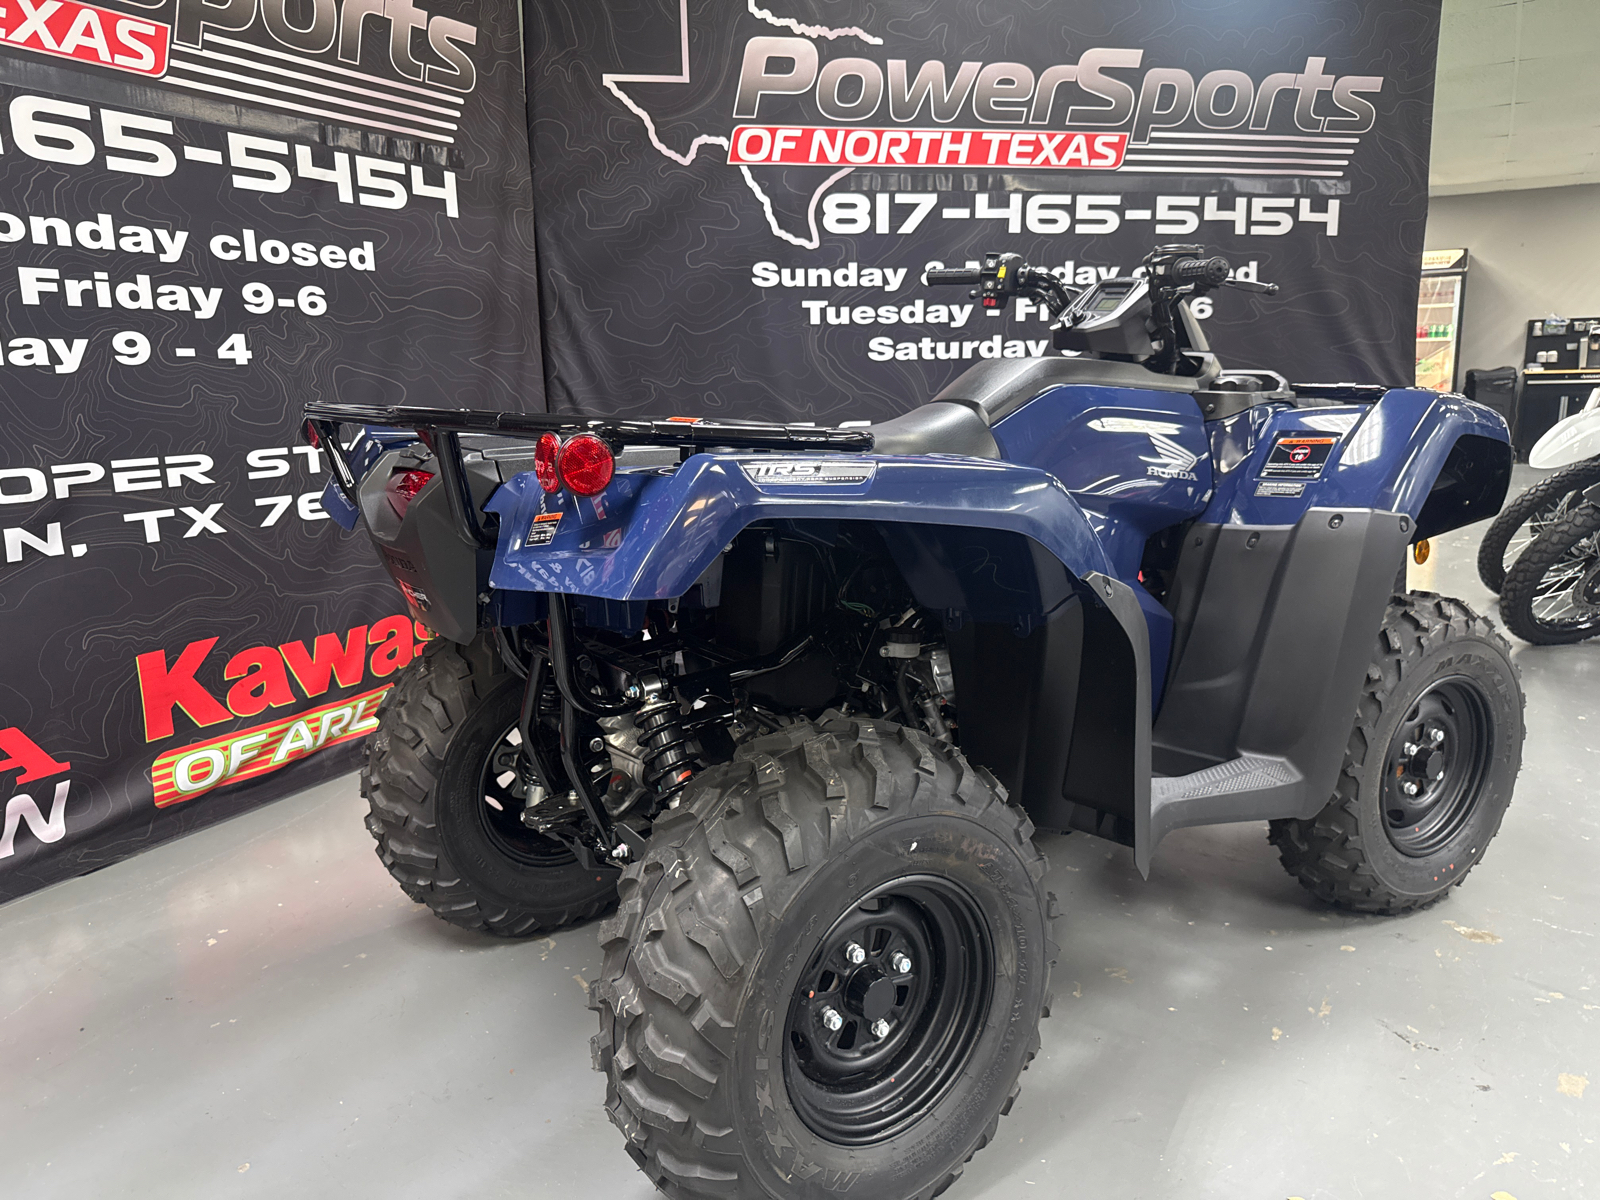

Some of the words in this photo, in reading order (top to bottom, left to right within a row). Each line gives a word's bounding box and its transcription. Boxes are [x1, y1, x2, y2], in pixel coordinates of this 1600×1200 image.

[0, 0, 155, 71] XAS
[733, 36, 1384, 145] PowerSports
[0, 95, 459, 218] 65-5454
[737, 129, 802, 161] OF
[808, 130, 972, 164] NORTH
[981, 133, 1119, 166] TEXAS
[822, 193, 1340, 236] 817-465-5454
[209, 229, 376, 271] closed
[17, 266, 223, 319] Friday
[241, 283, 328, 316] 9-6
[751, 261, 908, 292] Sunday
[801, 299, 974, 328] Tuesday
[0, 337, 89, 374] ay
[112, 331, 152, 366] 9
[217, 333, 253, 365] 4
[868, 334, 1049, 360] Saturday
[1146, 466, 1199, 481] HONDA
[123, 503, 227, 544] TX
[174, 733, 267, 793] OF
[272, 690, 388, 763] ARL
